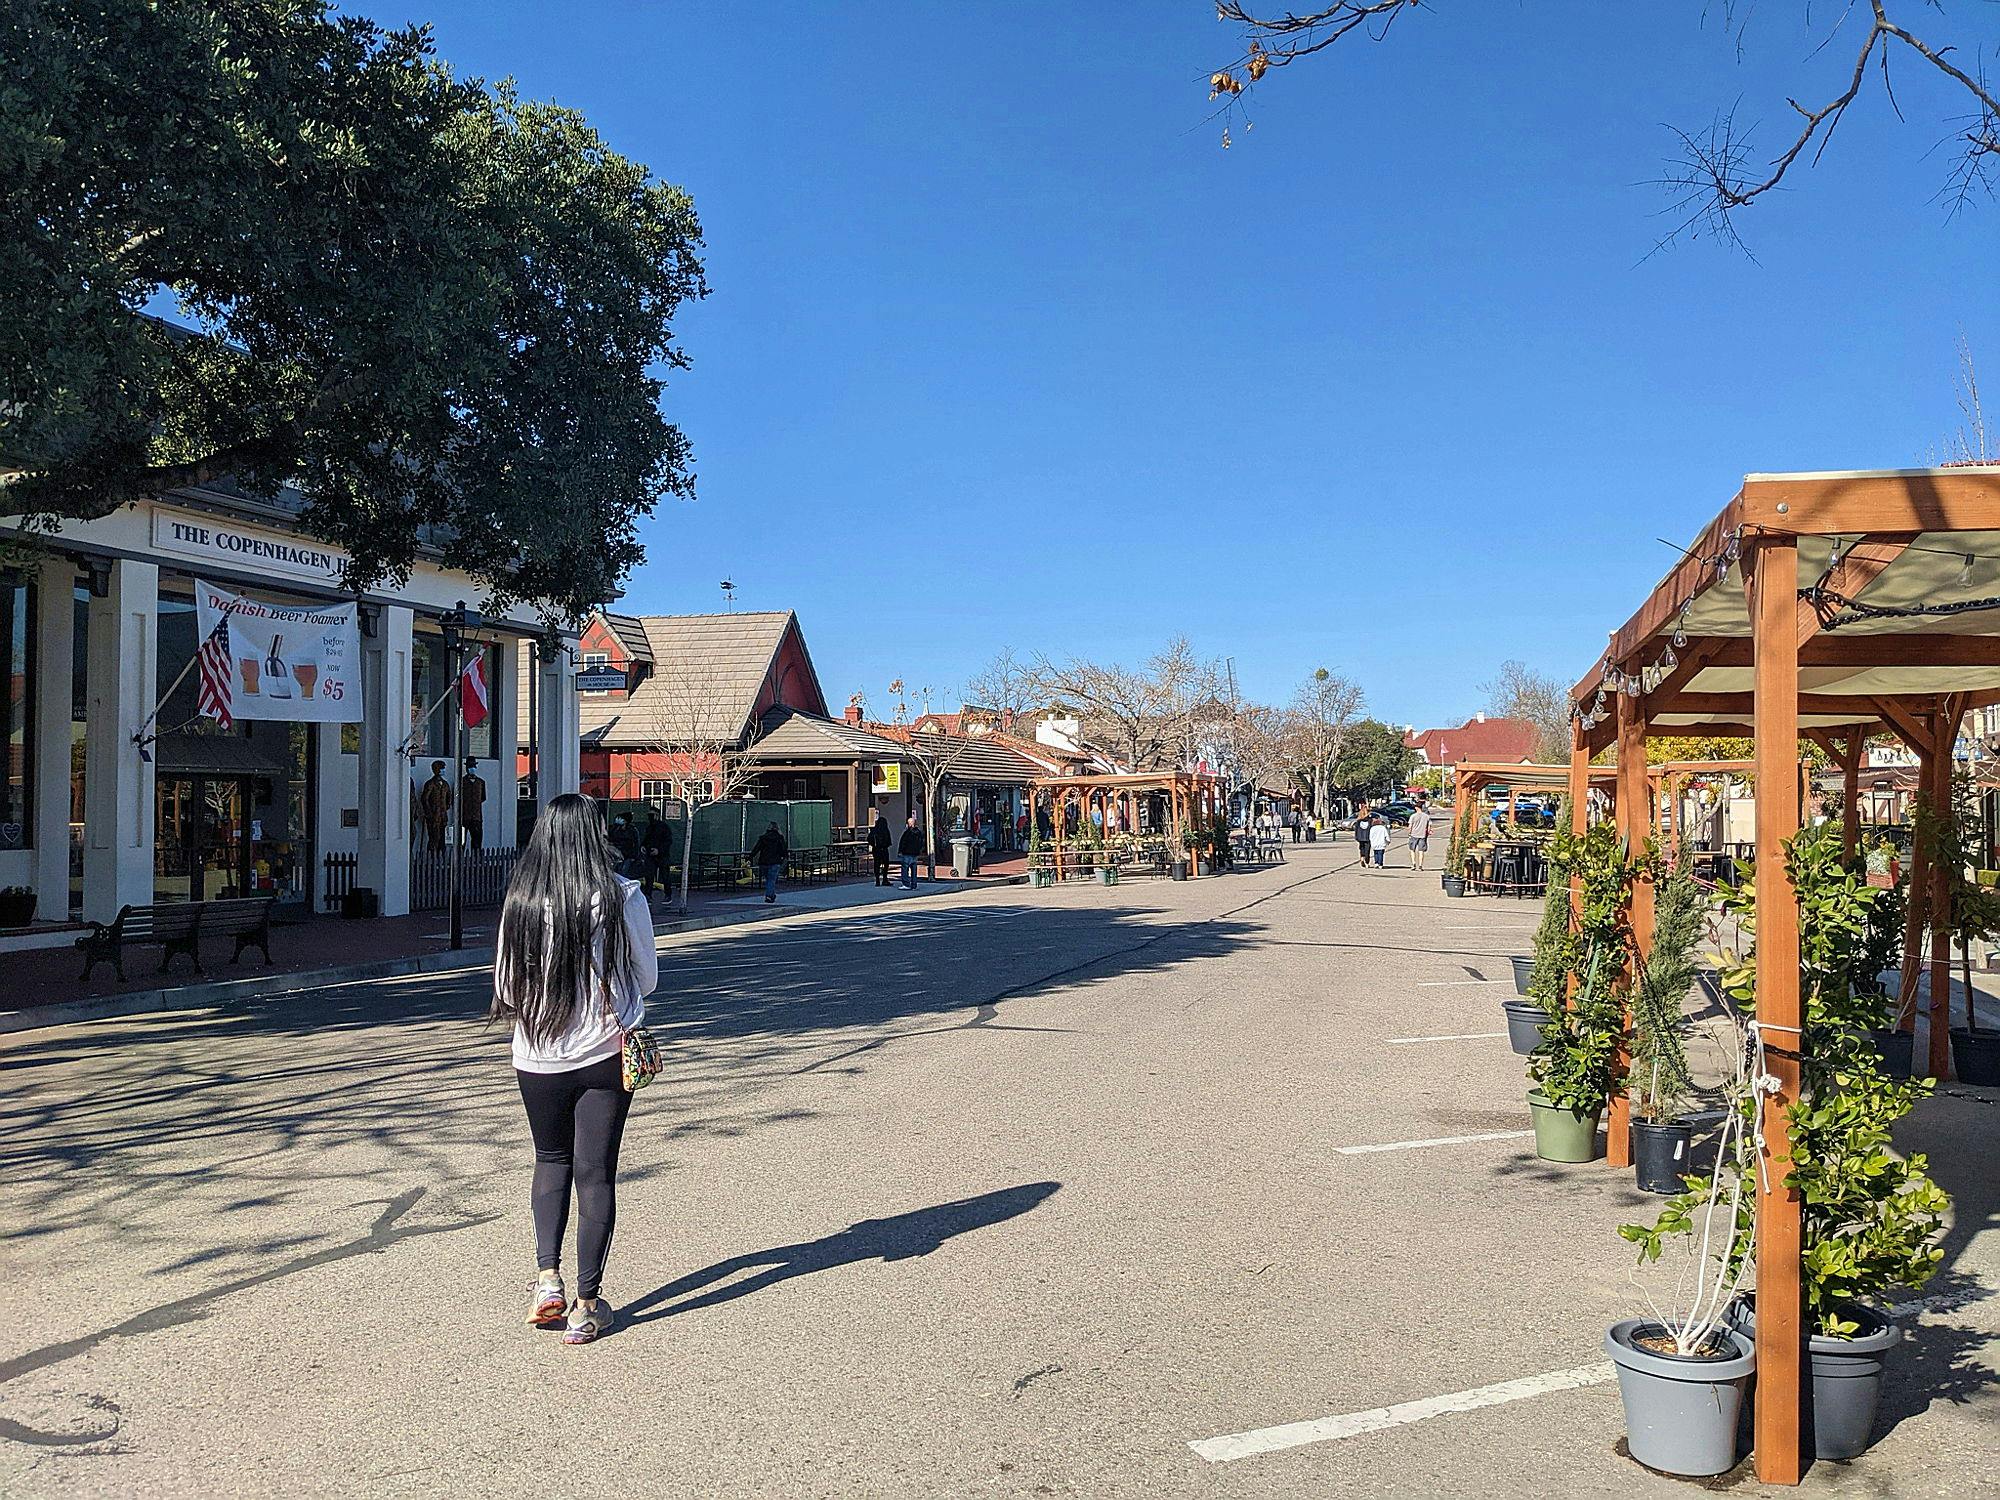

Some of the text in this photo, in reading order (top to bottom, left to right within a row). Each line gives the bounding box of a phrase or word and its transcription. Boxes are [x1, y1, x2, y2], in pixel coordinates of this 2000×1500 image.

[171, 522, 210, 546] THE
[215, 532, 331, 570] COPENHAGEN
[207, 594, 348, 626] Danish Beer Foamer
[322, 676, 345, 701] $5
